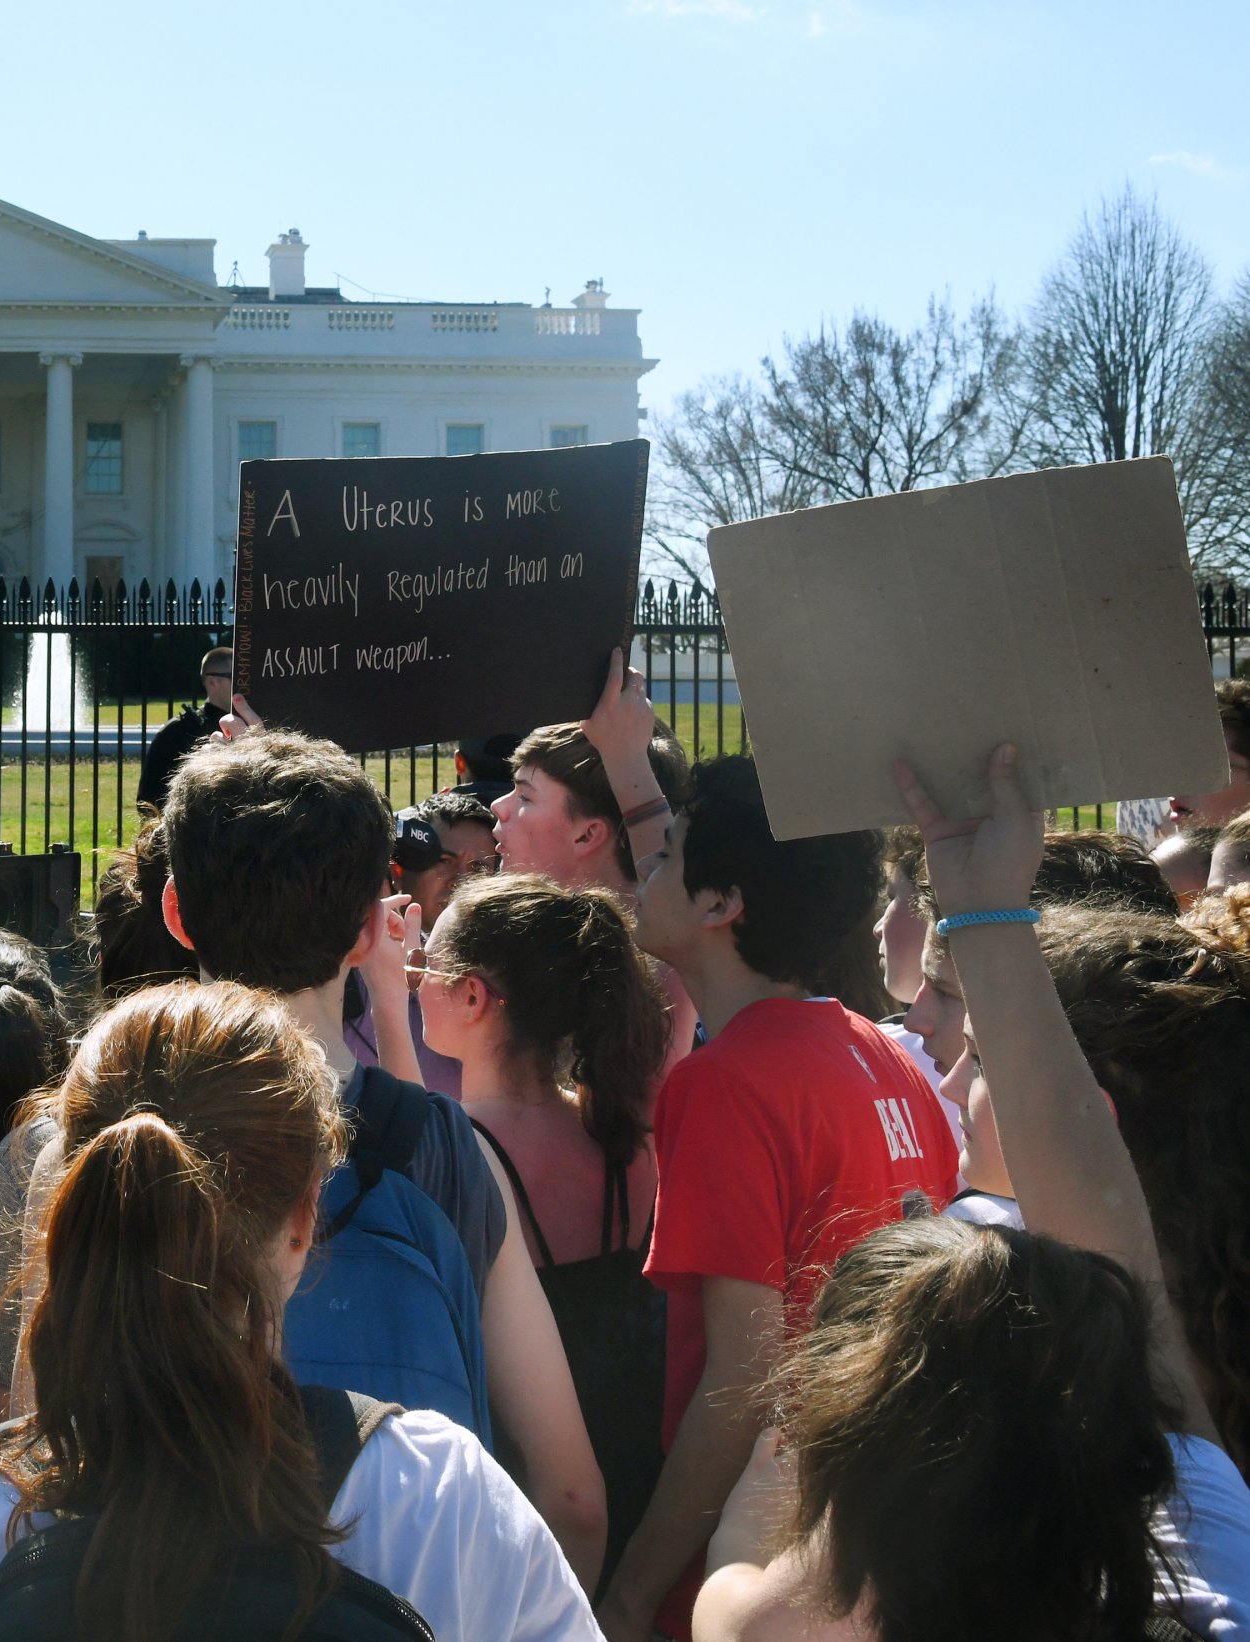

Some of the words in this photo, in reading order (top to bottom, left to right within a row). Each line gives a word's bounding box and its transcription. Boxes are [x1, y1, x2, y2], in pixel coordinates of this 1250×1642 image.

[267, 489, 301, 537] A
[464, 489, 484, 523] is
[263, 562, 359, 617] heavily
[505, 555, 548, 587] than
[560, 552, 584, 579] an
[262, 644, 340, 678] ASSAULT
[409, 827, 430, 843] NBC
